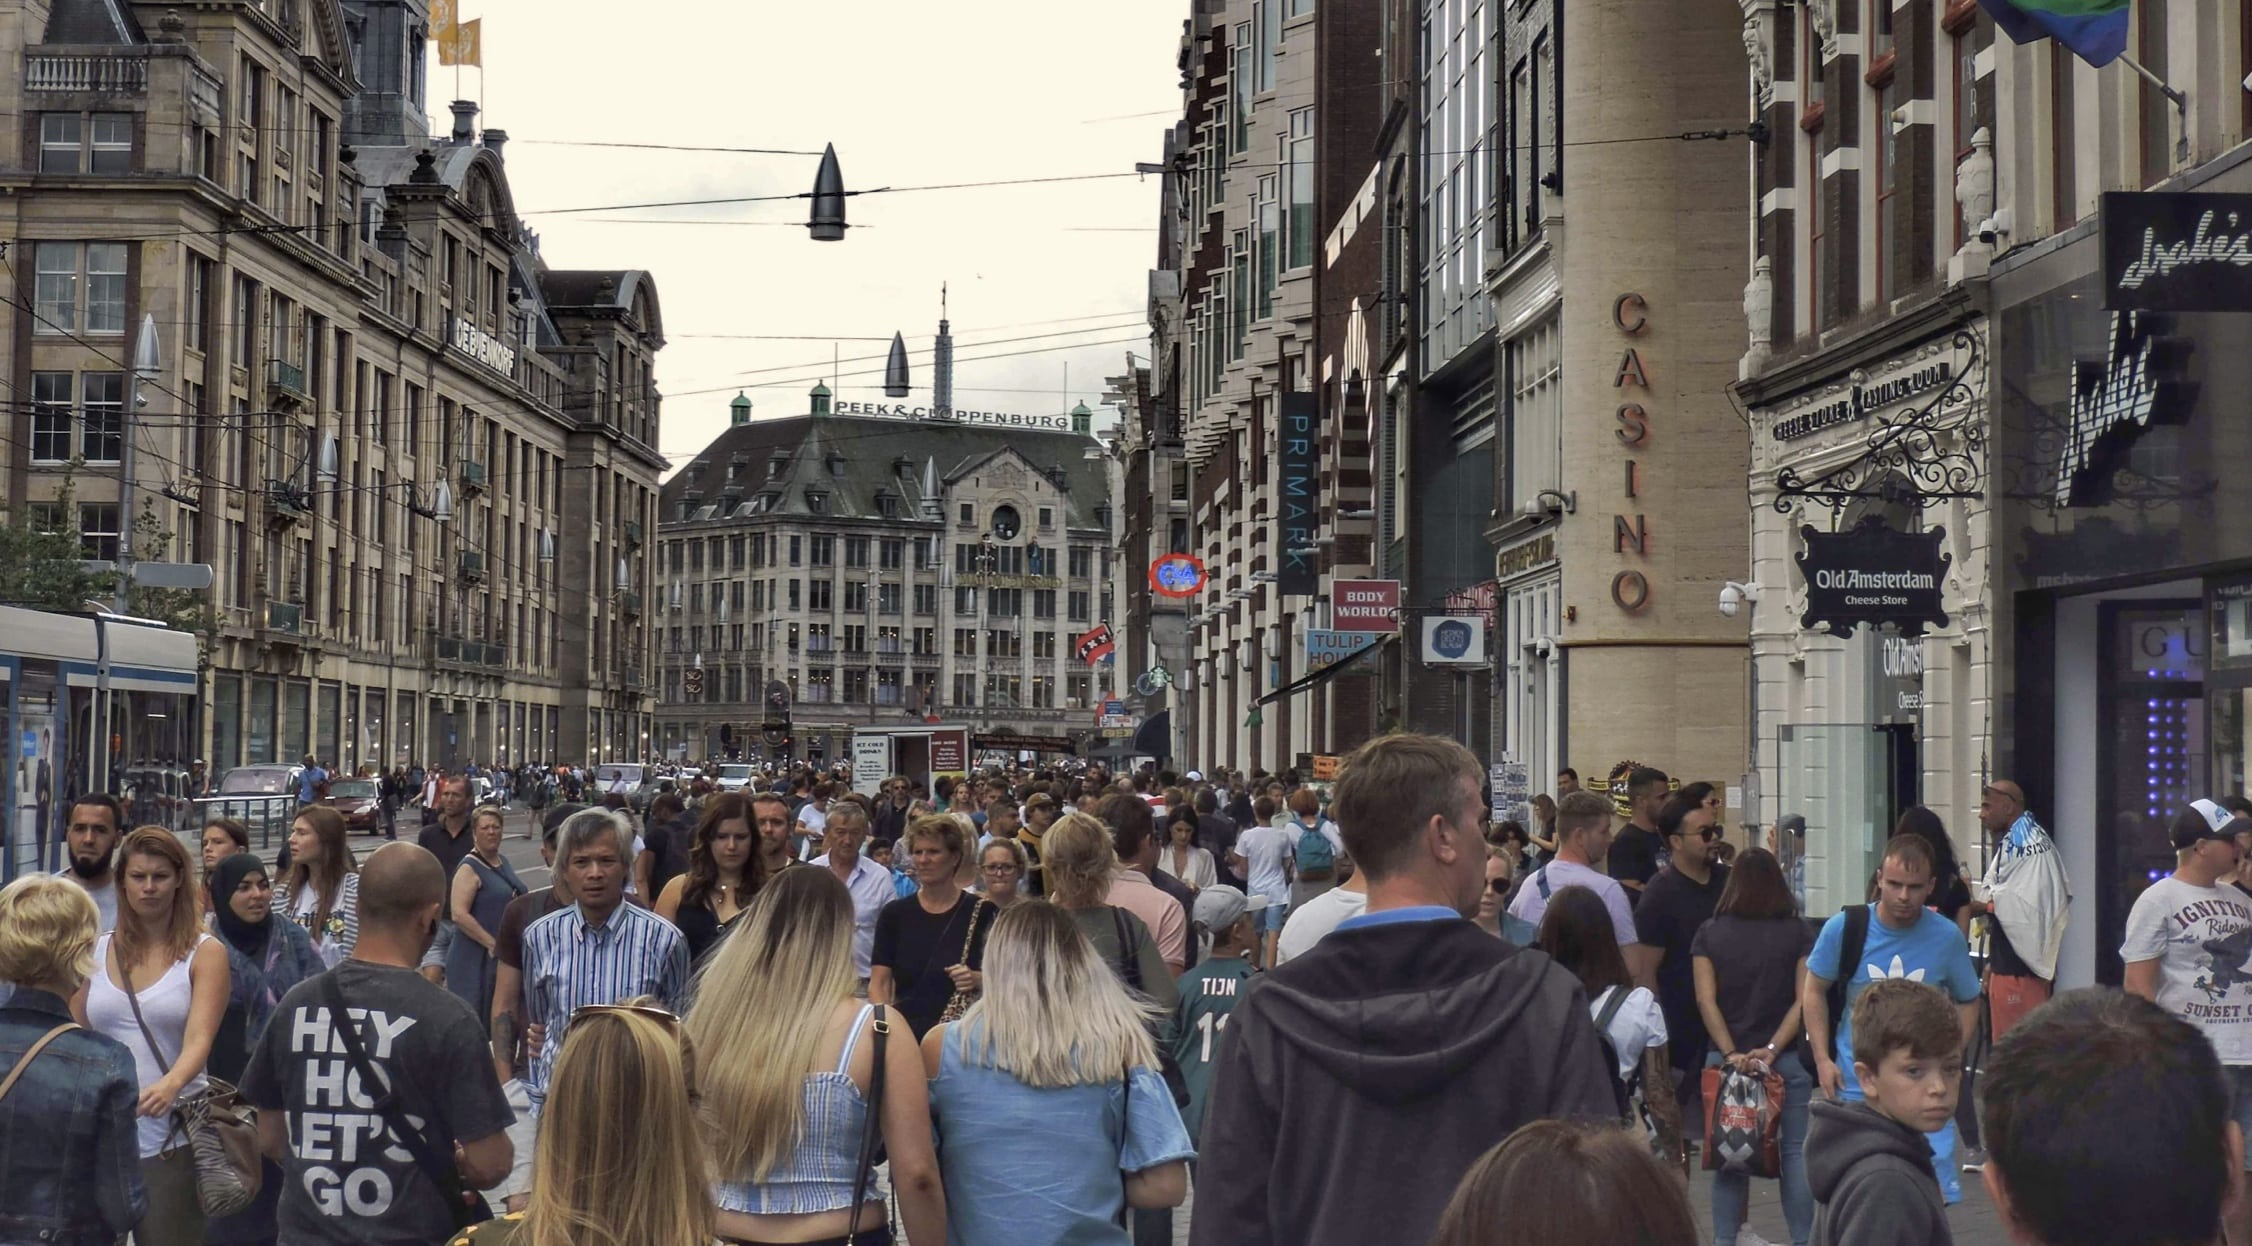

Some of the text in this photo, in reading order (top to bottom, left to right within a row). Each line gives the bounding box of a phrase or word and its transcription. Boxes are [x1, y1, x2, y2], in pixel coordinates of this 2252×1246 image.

[836, 401, 888, 415] PEEK
[913, 406, 1069, 428] CLOPPENBURG
[1611, 292, 1648, 610] CASINO
[1286, 415, 1308, 569] PRIMARK
[1816, 569, 1934, 589] Old Amsterdam
[1346, 591, 1385, 602] BODY
[1845, 595, 1908, 605] Cheese Store
[1314, 634, 1364, 649] TULIP
[1883, 637, 1899, 677] Old
[1899, 691, 1918, 709] Cheese
[1202, 977, 1236, 996] TIJN
[2184, 1002, 2241, 1018] SUNSET
[305, 1058, 392, 1109] HO
[303, 1165, 394, 1217] GO
